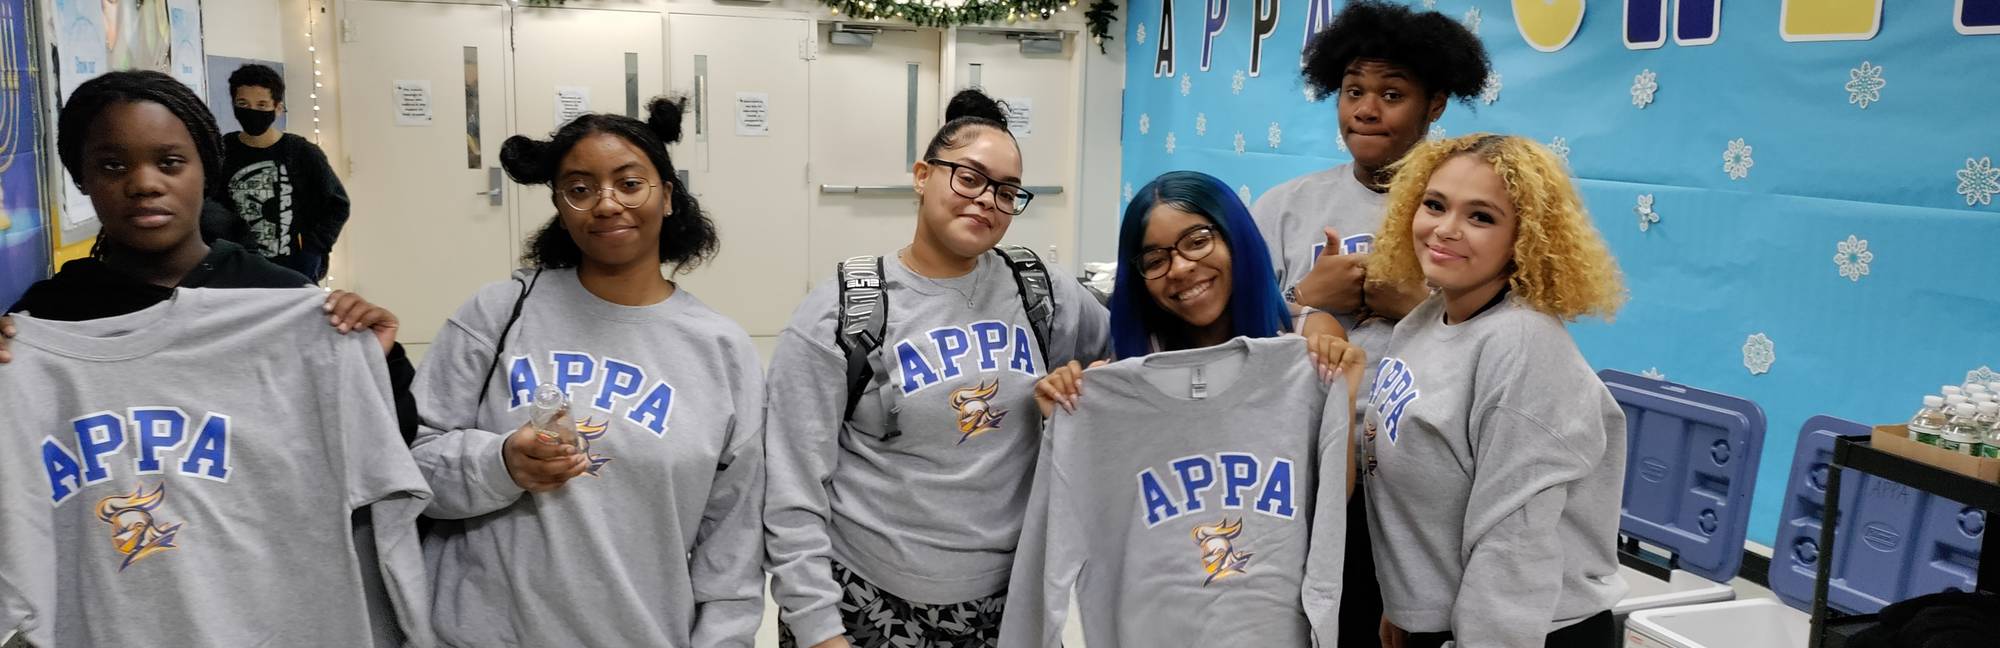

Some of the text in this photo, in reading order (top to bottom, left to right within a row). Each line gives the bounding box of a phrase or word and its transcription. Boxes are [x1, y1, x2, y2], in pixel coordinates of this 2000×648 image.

[507, 351, 676, 438] APPA
[894, 320, 1038, 397] APPA
[1367, 357, 1420, 446] APPA
[40, 406, 232, 508] APPA
[1136, 452, 1297, 529] APPA
